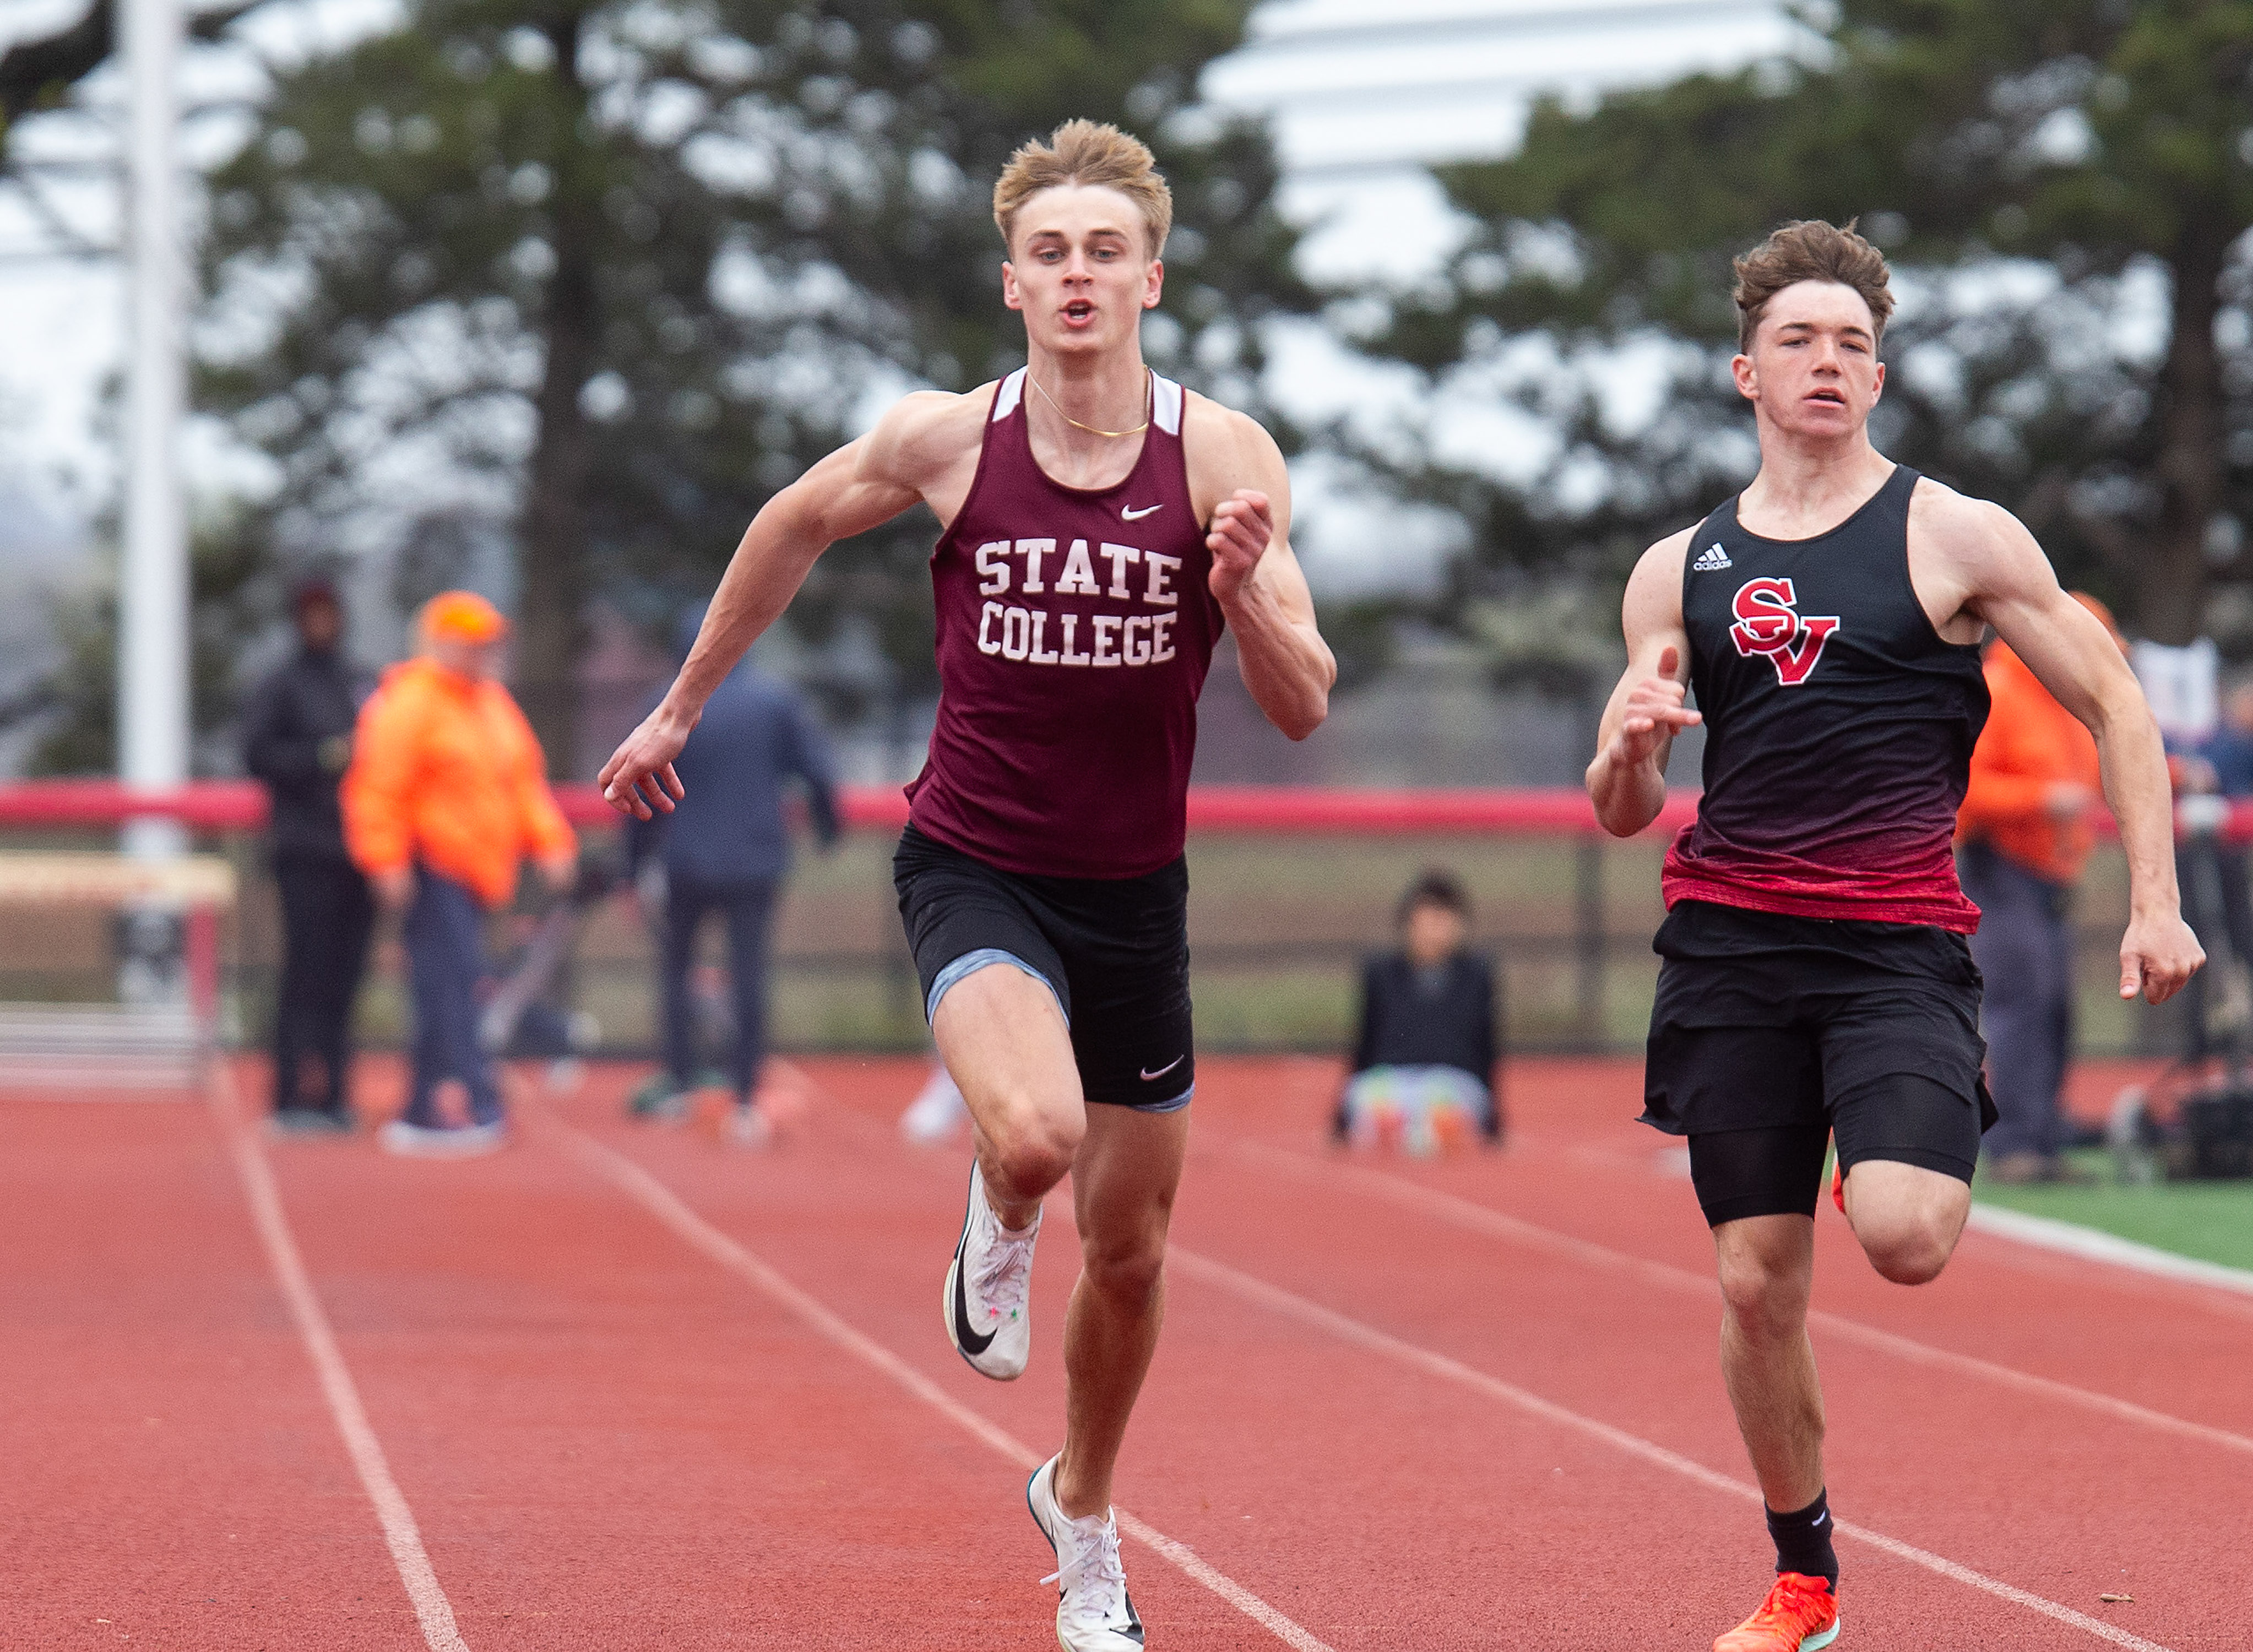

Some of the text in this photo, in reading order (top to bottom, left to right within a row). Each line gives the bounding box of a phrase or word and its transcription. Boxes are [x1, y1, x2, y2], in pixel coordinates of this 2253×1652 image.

[975, 539, 1182, 605] STATE
[1693, 558, 1732, 570] adidas
[978, 601, 1177, 667] COLLEGE
[1729, 577, 1841, 686] SV
